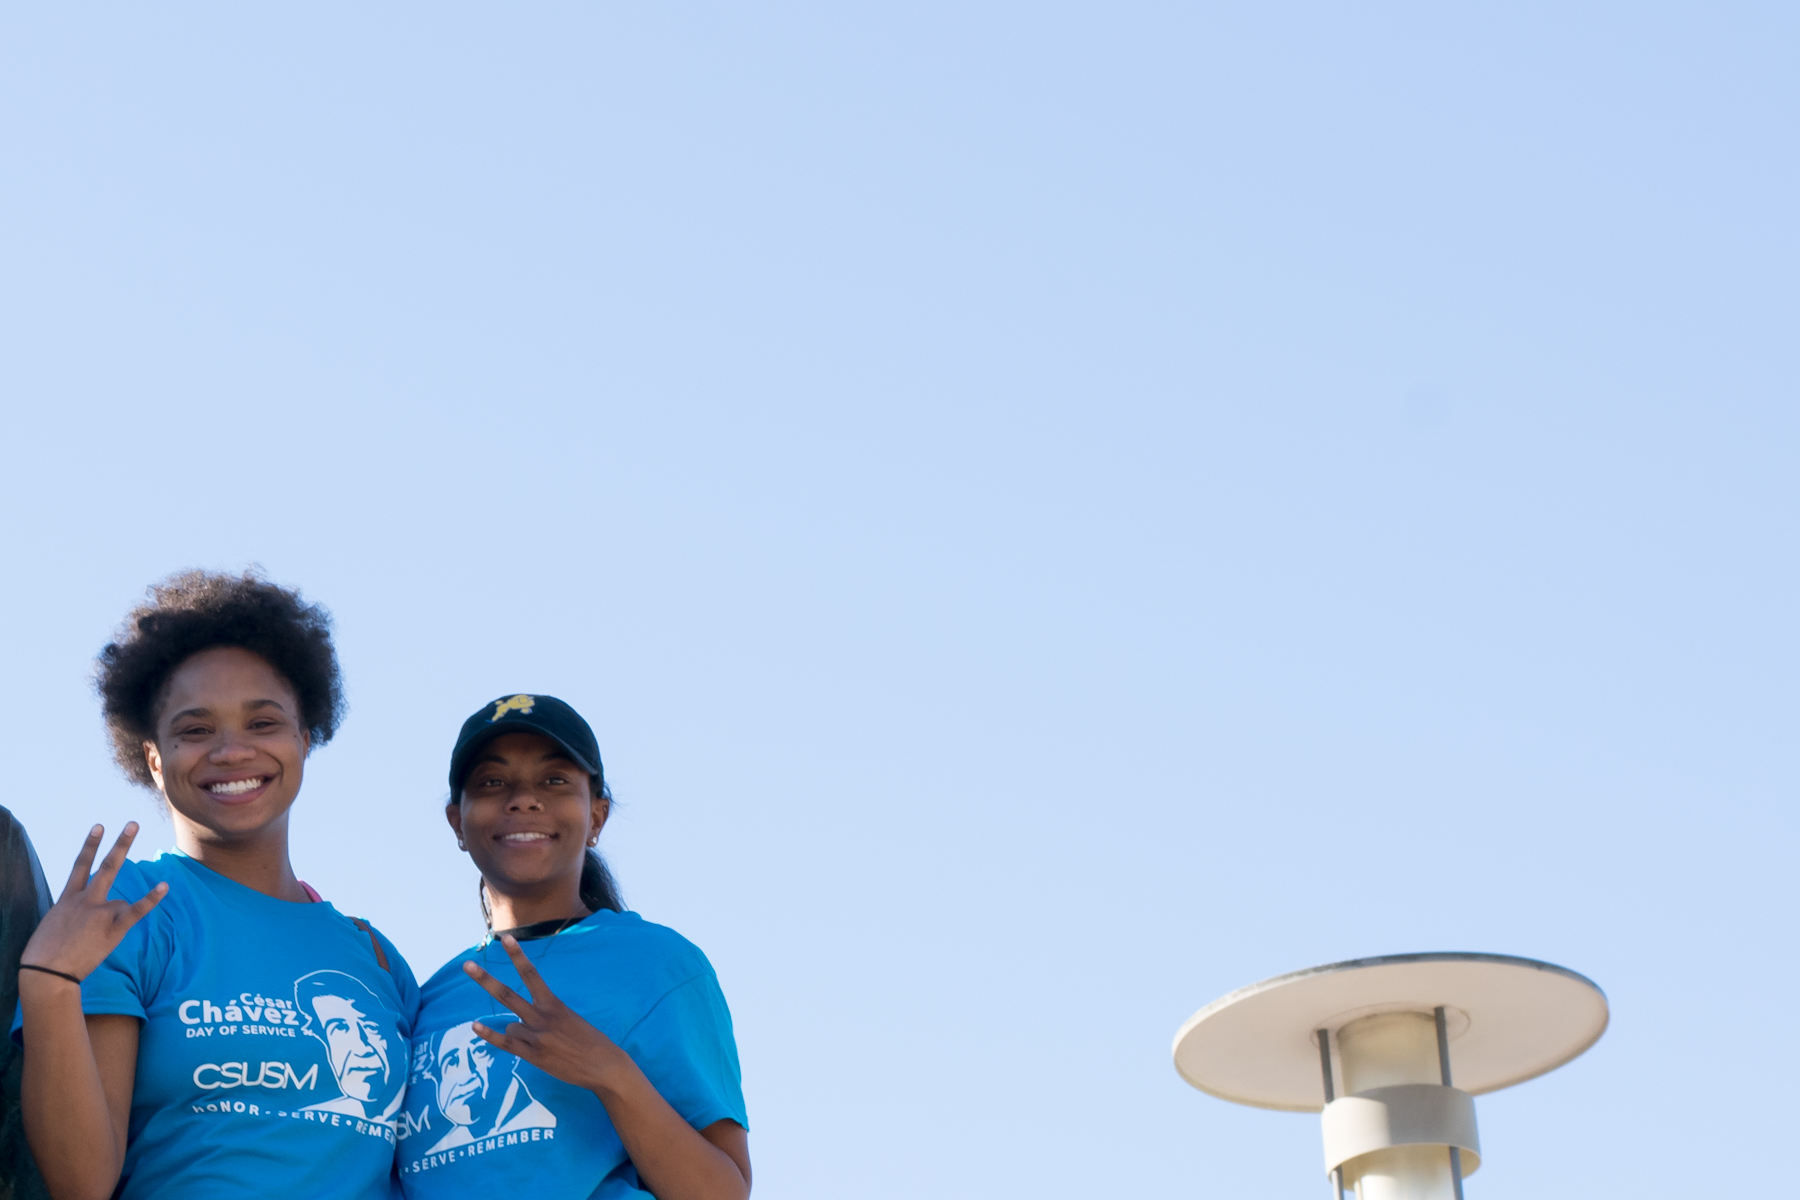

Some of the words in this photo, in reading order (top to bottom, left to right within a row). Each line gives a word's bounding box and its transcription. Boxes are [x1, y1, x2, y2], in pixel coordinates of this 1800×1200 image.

[178, 997, 299, 1026] Chávez
[239, 993, 293, 1010] César
[186, 1027, 214, 1038] DAY
[219, 1025, 238, 1036] OF
[242, 1025, 296, 1038] SERVICE
[193, 1061, 319, 1091] CSUSM
[192, 1100, 260, 1116] HONOR
[412, 1150, 456, 1173] SERVE
[467, 1128, 554, 1157] REMEMBER
